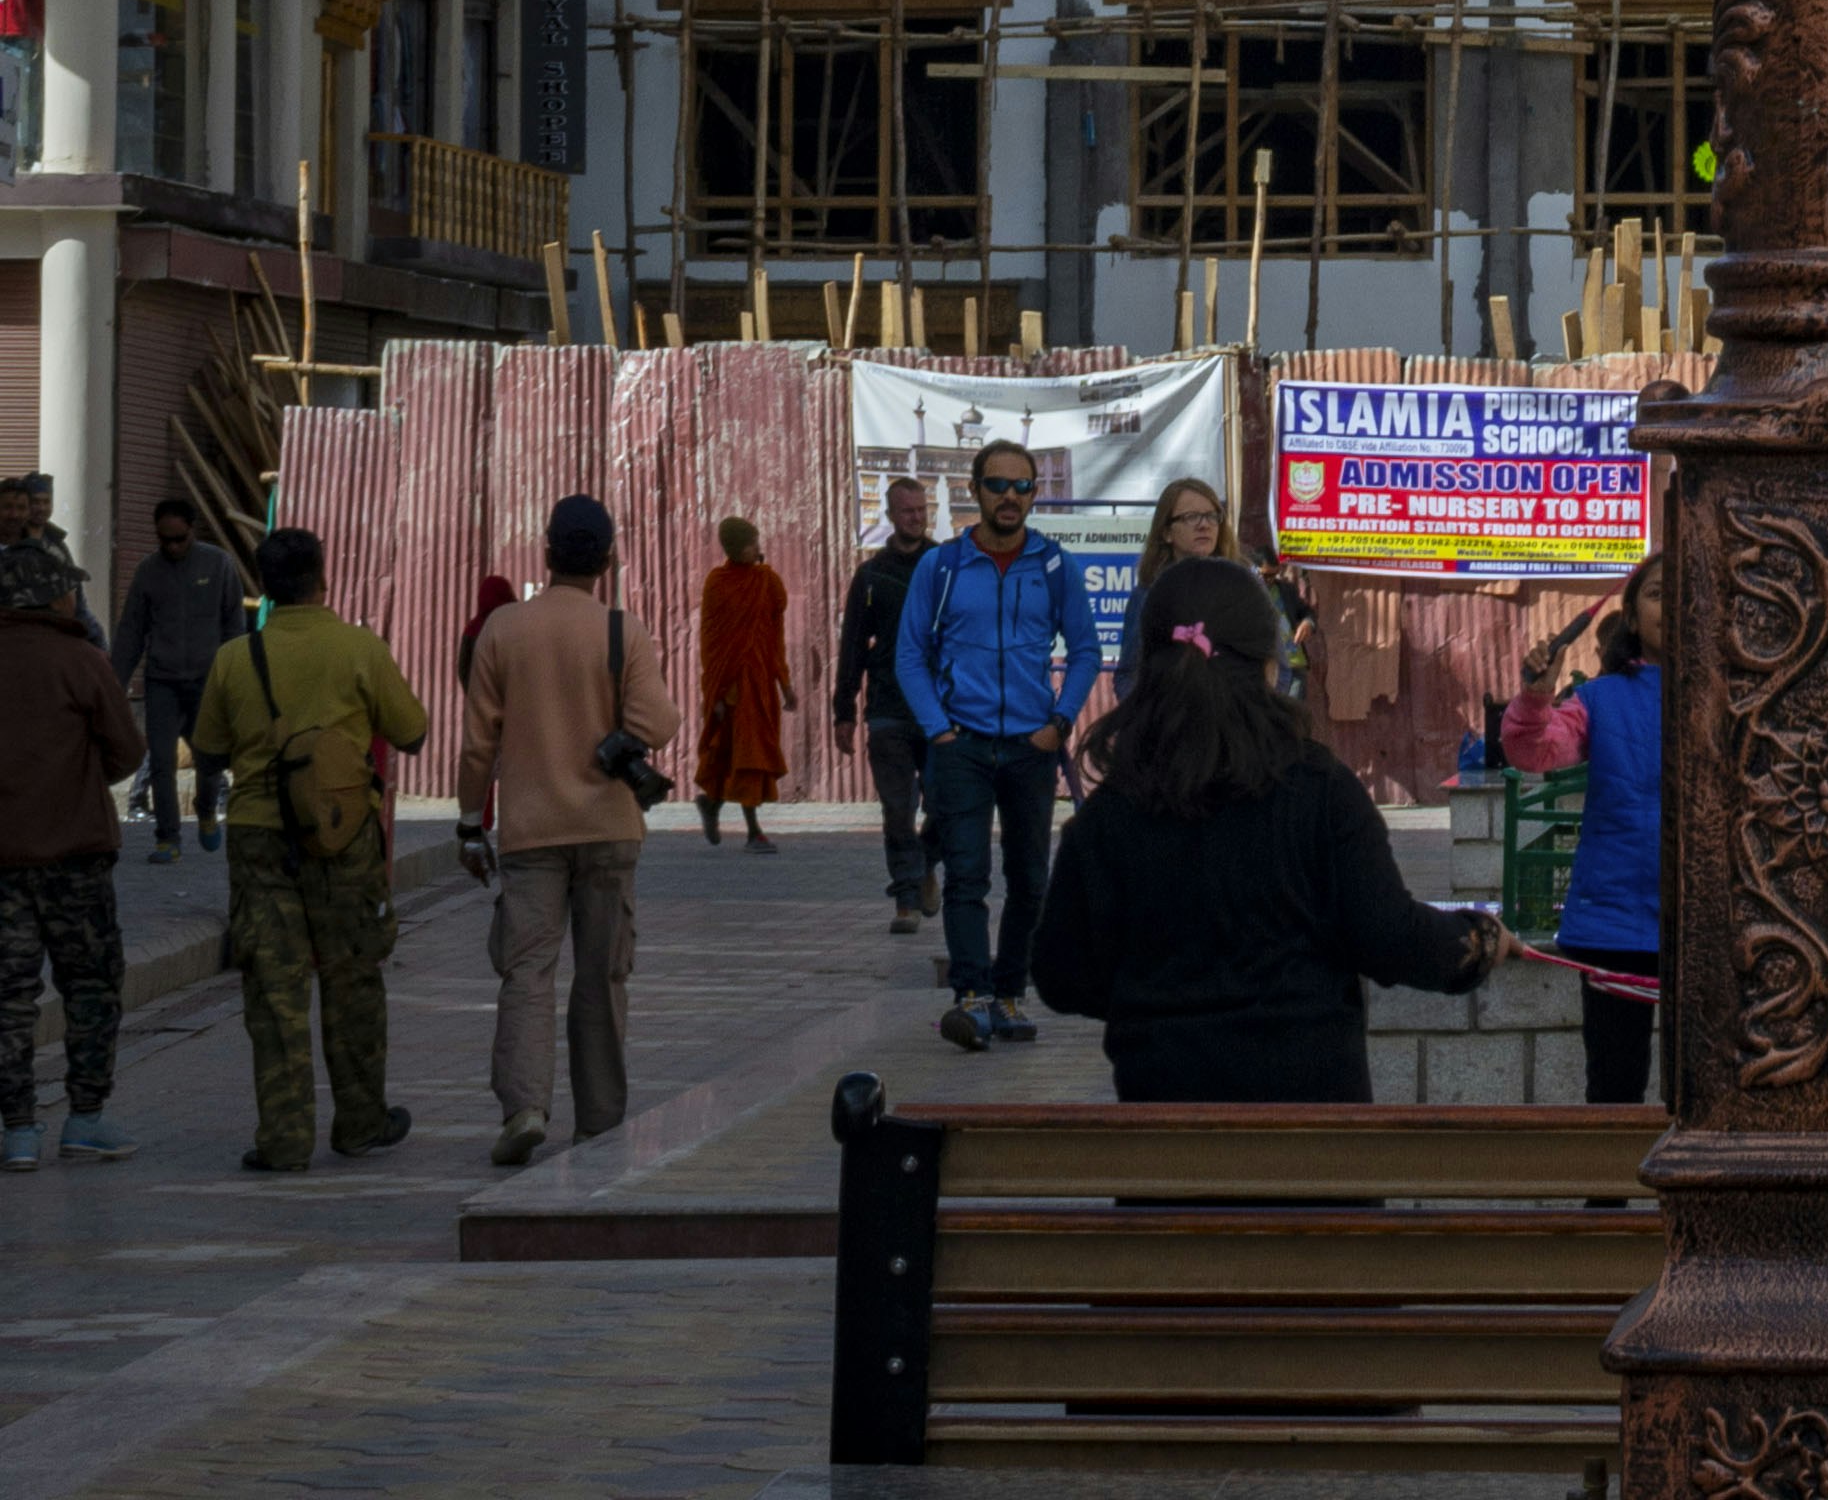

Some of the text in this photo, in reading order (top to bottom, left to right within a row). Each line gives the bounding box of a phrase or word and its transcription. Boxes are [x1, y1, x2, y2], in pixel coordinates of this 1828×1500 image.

[537, 61, 569, 164] SHOPEE
[1284, 388, 1474, 438] ISLAMIA
[1483, 392, 1578, 423] PUBLIC
[1482, 424, 1644, 458] SCHOOL, LE
[1339, 457, 1642, 495] ADMISSION OPEN
[1338, 492, 1641, 521] PRE- NURSERY TO 9TH
[1084, 532, 1148, 544] ADMINISTRA
[1280, 534, 1313, 544] Phone
[1285, 517, 1640, 538] REGISTRATION STARTS FROM 01 OCTOBER
[1084, 565, 1139, 592] SM
[1469, 561, 1526, 572] ADMISSION
[1528, 563, 1551, 572] FREE
